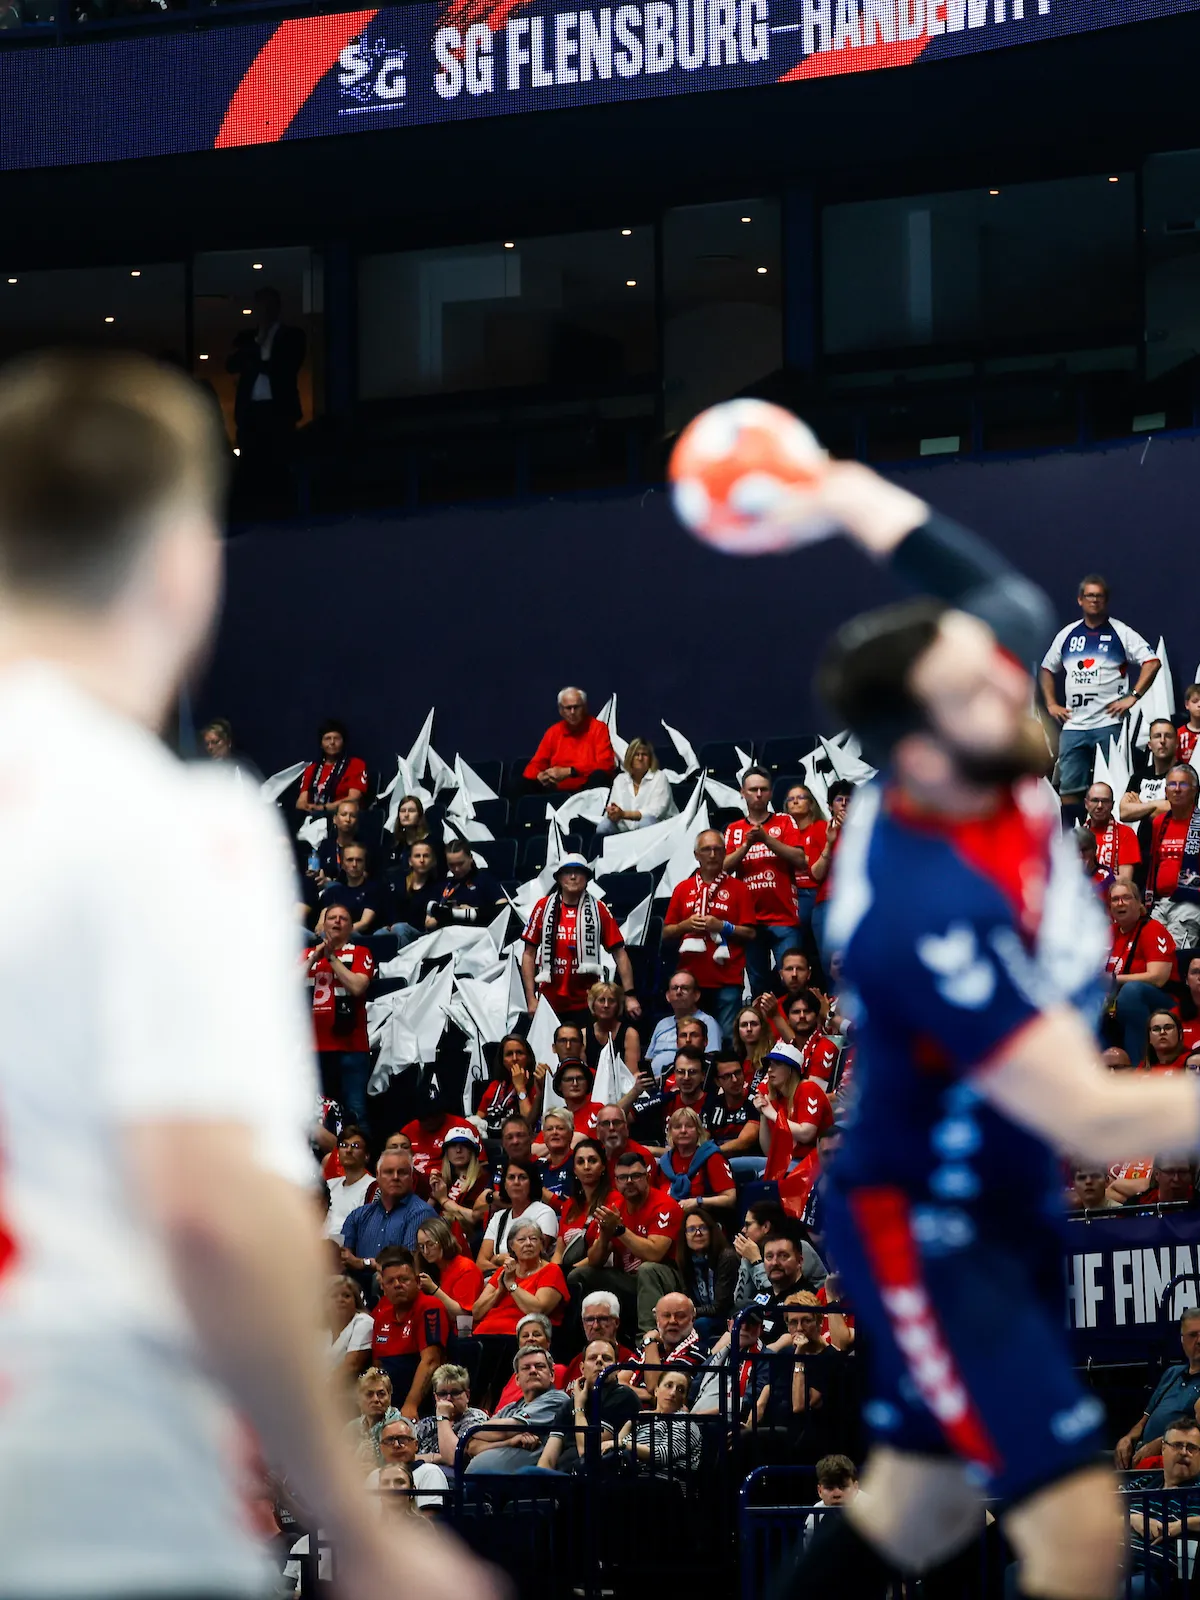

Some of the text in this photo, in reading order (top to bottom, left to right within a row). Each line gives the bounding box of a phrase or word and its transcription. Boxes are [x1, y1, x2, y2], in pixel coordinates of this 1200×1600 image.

[433, 23, 495, 99] SG
[1069, 635, 1086, 653] 99
[734, 828, 743, 846] 9
